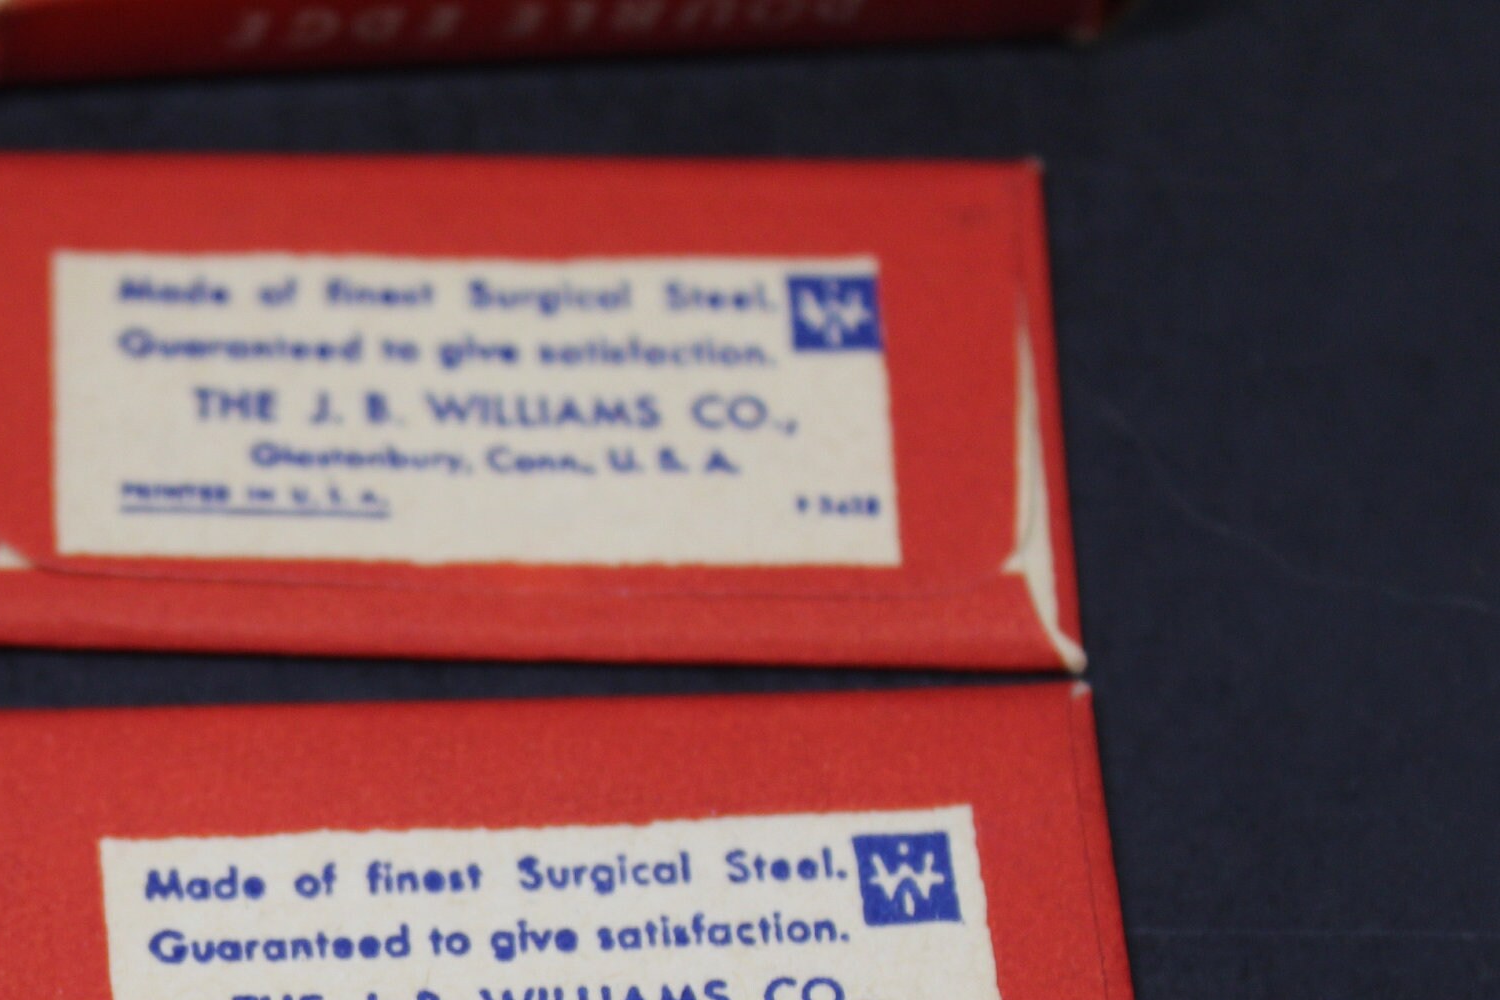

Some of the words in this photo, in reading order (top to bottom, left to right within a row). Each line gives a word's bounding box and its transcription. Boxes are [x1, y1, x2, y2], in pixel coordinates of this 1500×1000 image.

[117, 278, 231, 306] Made
[258, 279, 297, 307] of
[325, 277, 434, 308] finest
[468, 278, 630, 317] Surgical
[665, 281, 777, 312] Steel.
[117, 330, 361, 364] Guaranteed
[381, 339, 421, 363] to
[437, 336, 521, 371] give
[538, 338, 777, 368] satisfaction.
[194, 386, 276, 423] THE
[311, 393, 341, 425] J.
[364, 391, 403, 425] B.
[425, 394, 661, 430] WILLIAMS
[691, 394, 797, 434] CO.,
[249, 441, 472, 473] Glastonbury,
[658, 446, 686, 472] S.
[144, 865, 267, 901] Made
[293, 862, 337, 900] of
[366, 860, 483, 895] finest
[516, 850, 692, 896] Surgical
[724, 847, 848, 884] Steel.
[147, 923, 412, 965] Guaranteed
[428, 927, 472, 957] to
[489, 919, 579, 963] give
[596, 911, 850, 952] satisfaction.
